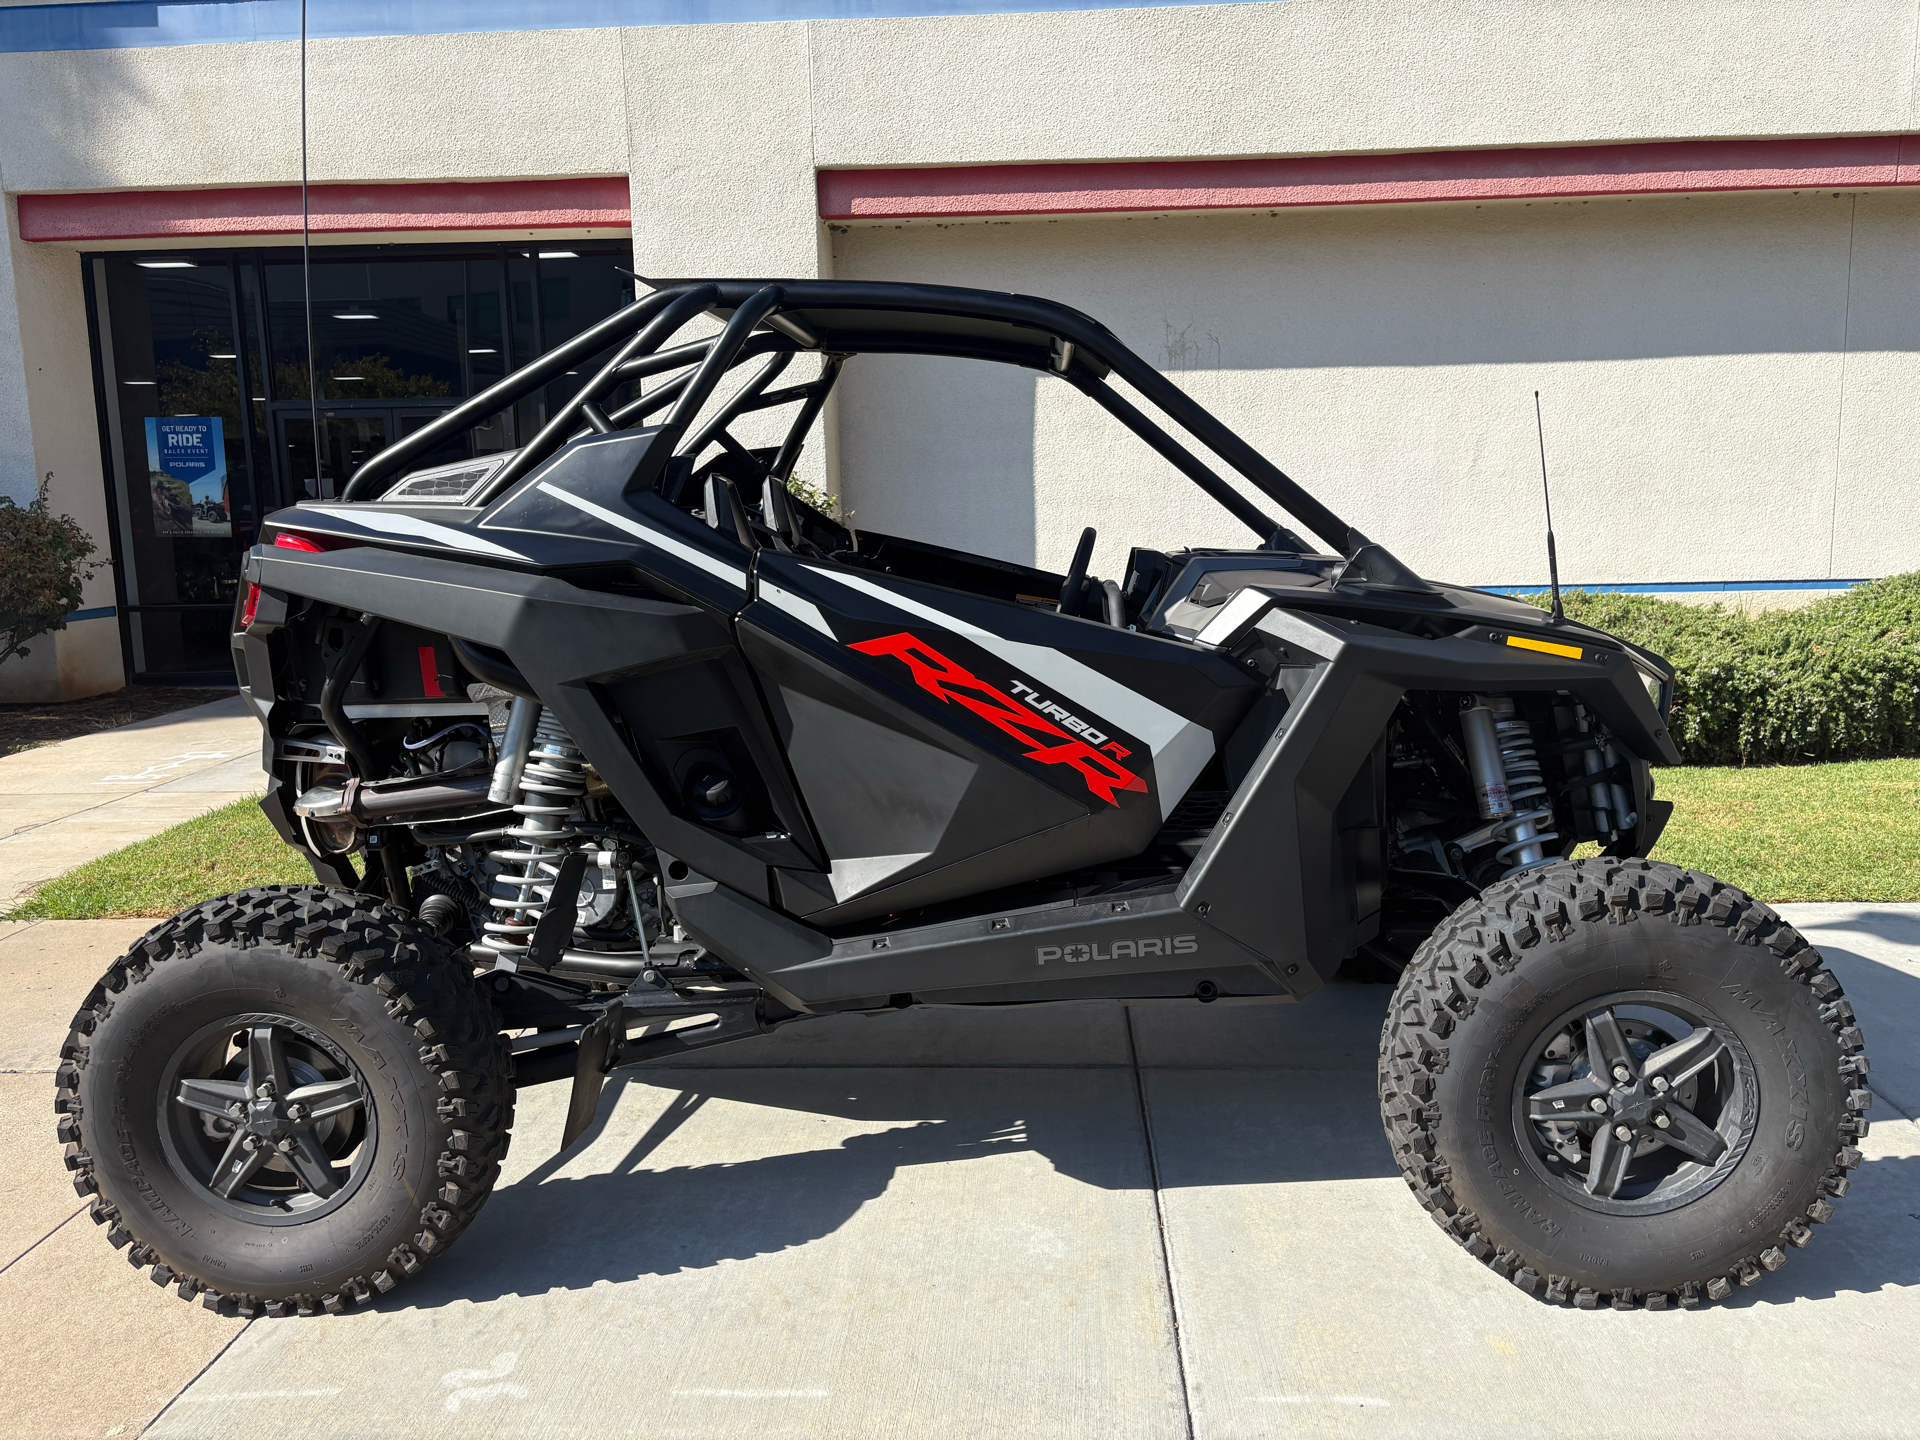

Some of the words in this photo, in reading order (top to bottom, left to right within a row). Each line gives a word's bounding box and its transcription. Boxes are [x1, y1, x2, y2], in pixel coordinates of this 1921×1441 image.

[167, 433, 203, 447] RIDE
[846, 632, 1149, 809] RZR
[1009, 679, 1109, 745] TURBO
[1100, 741, 1132, 761] R
[1036, 934, 1199, 966] POLARIS
[330, 1017, 409, 1182] MAXXIS
[1720, 983, 1809, 1152] MAXXIS
